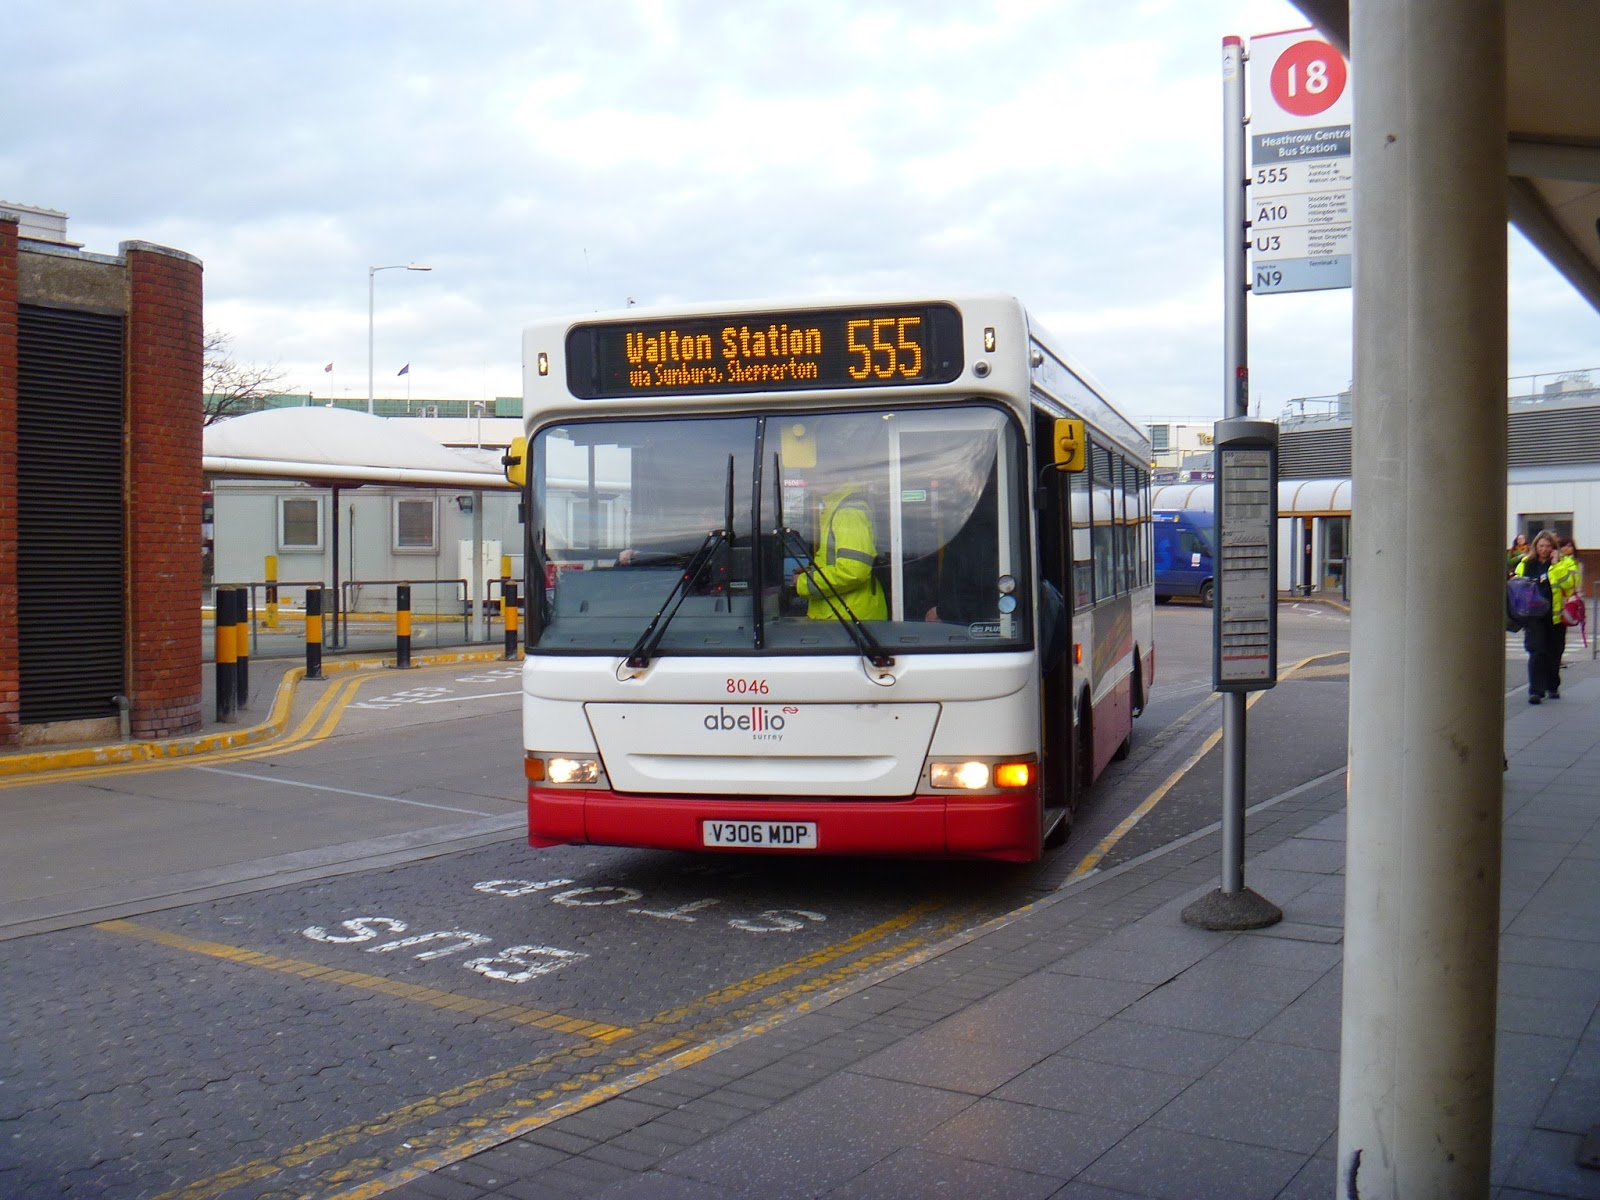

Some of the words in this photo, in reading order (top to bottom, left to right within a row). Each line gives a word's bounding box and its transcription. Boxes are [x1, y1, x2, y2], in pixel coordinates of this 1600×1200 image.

[1287, 60, 1329, 98] 18
[1261, 133, 1313, 147] Heathrow
[1314, 129, 1351, 141] Centra
[1278, 147, 1298, 158] Bus
[1299, 142, 1338, 155] Station
[1256, 167, 1288, 185] 555
[1257, 205, 1288, 222] A10
[1256, 235, 1281, 252] U3
[1256, 271, 1283, 287] N9
[626, 330, 713, 364] Walton
[721, 323, 822, 359] Station
[847, 316, 922, 380] 555
[629, 365, 651, 387] via
[726, 678, 769, 694] 8046
[344, 687, 454, 710] KEEP
[704, 706, 785, 732] abellio
[752, 733, 784, 741] surrey
[712, 823, 763, 843] V306
[768, 824, 808, 844] MDP
[472, 879, 828, 933] STOP
[302, 916, 590, 984] BUS
